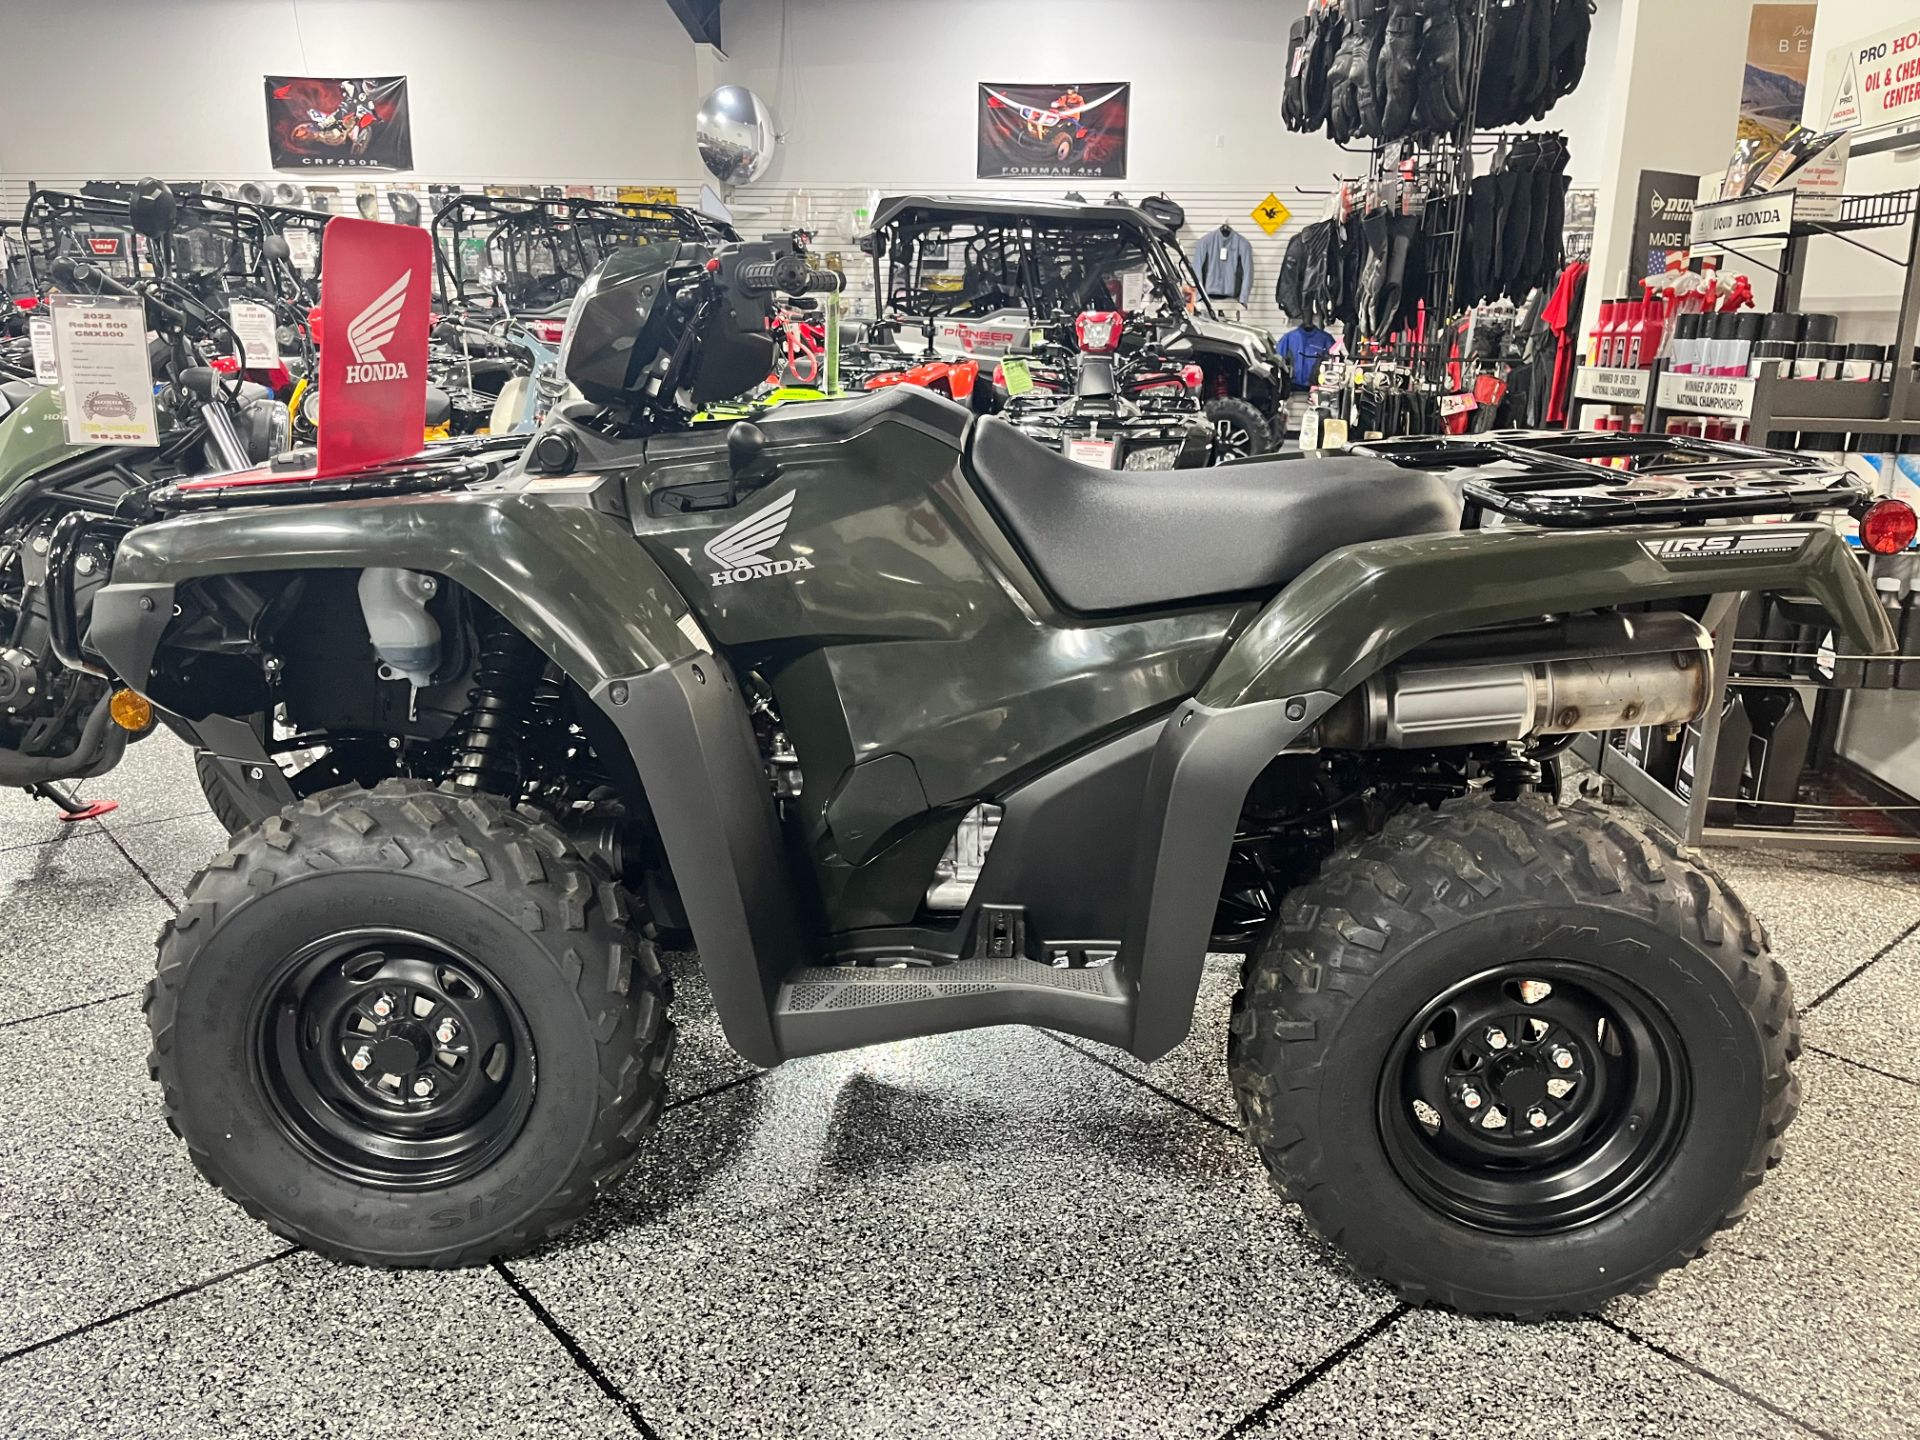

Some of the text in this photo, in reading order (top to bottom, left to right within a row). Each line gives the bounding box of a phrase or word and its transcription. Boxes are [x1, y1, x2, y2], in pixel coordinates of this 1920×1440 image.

[1859, 31, 1920, 65] PRO HO
[1865, 57, 1920, 92] OIL & CHE
[1839, 95, 1853, 105] PRO
[302, 158, 379, 166] CRF450R
[1002, 166, 1102, 174] FOREMAN 4x4
[1713, 209, 1781, 231] LIQUID HONDA
[1649, 232, 1682, 246] MADE
[68, 321, 103, 329] Rebel
[75, 330, 124, 338] CMX500
[944, 328, 1014, 342] PIONEER
[346, 362, 409, 384] HONDA
[1599, 373, 1613, 383] WINNER
[1614, 374, 1620, 384] OF
[1620, 374, 1630, 385] OVER
[1685, 380, 1738, 395] WINNER OF OVER 50
[1677, 393, 1744, 411] NATIONAL CHAMPIONSHIPS
[1661, 536, 1735, 553] IRS
[710, 556, 816, 587] HONDA
